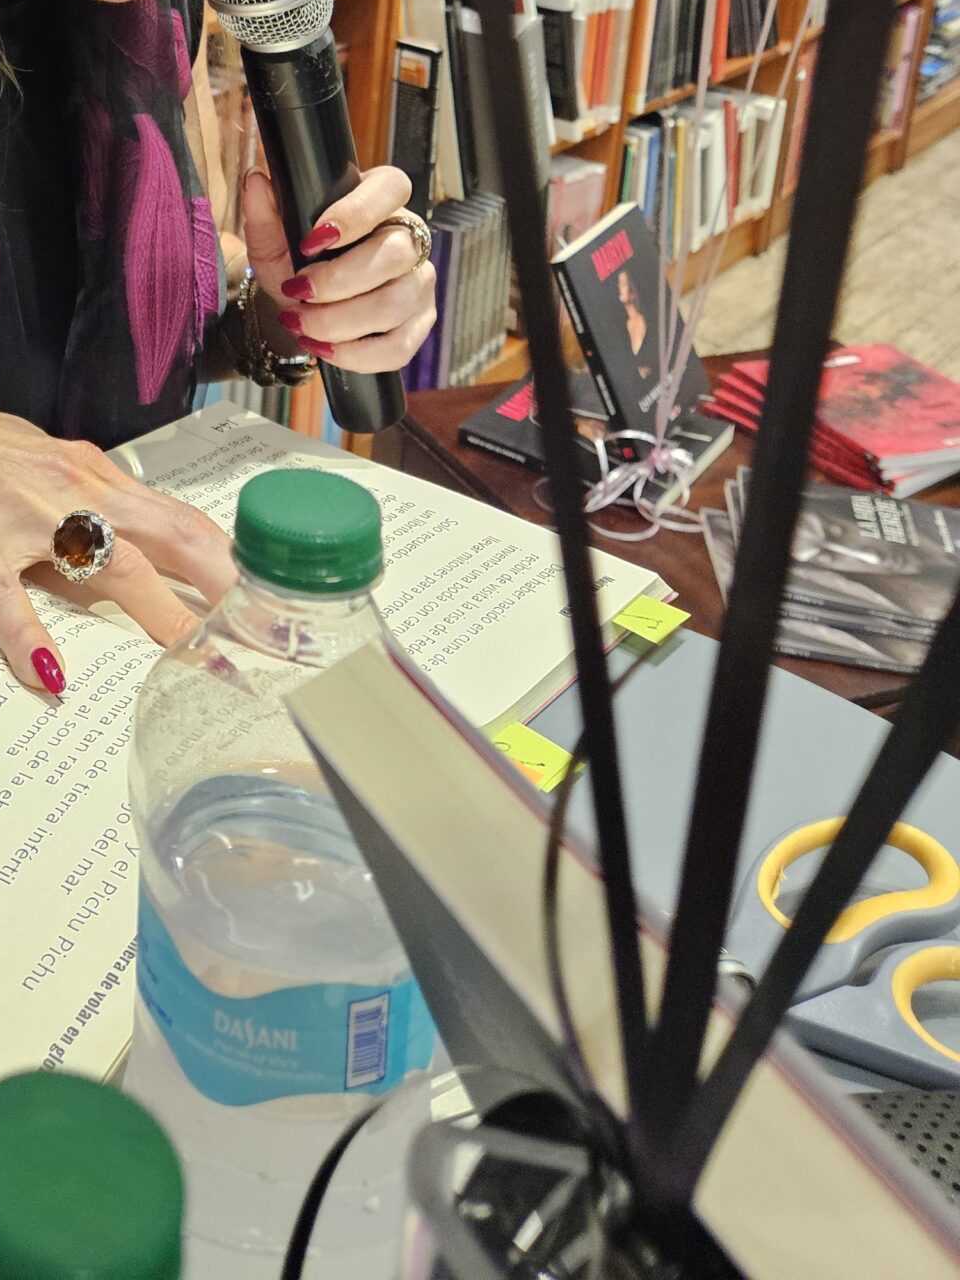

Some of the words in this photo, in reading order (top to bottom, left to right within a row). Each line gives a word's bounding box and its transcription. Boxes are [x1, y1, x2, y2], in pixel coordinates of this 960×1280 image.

[210, 419, 240, 433] 144
[394, 501, 417, 515] que
[418, 509, 437, 524] un
[392, 514, 428, 537] librito
[431, 517, 460, 533] Solo
[391, 530, 436, 560] recuerdo
[469, 535, 502, 555] llevar
[432, 551, 474, 579] mitones
[479, 544, 523, 572] inventar
[507, 553, 540, 581] recibir
[409, 574, 437, 595] para
[435, 577, 470, 602] boda
[457, 569, 485, 589] una
[495, 573, 515, 588] de
[511, 574, 546, 601] haber
[460, 600, 480, 611] la
[471, 583, 501, 609] visita
[415, 601, 440, 617] con
[442, 608, 467, 625] risa
[480, 597, 516, 625] nacido
[426, 623, 449, 643] de
[465, 622, 484, 636] en
[405, 634, 437, 655] Fede
[441, 634, 471, 655] cuna
[427, 649, 449, 666] de
[62, 651, 117, 693] dormía
[88, 658, 143, 703] cantaba
[4, 680, 21, 694] y
[73, 704, 91, 720] al
[98, 695, 134, 726] mira
[46, 719, 77, 747] son
[74, 729, 105, 752] tan
[26, 749, 50, 770] de
[84, 759, 108, 779] de
[10, 771, 35, 786] la
[44, 755, 78, 786] rara
[44, 782, 91, 824] tierra
[90, 828, 120, 858] del
[124, 841, 141, 858] y
[60, 857, 95, 896] mar
[109, 860, 129, 880] el
[66, 880, 119, 932] Pichu
[21, 935, 75, 991] Pichu
[99, 971, 121, 991] de
[74, 991, 107, 1028] volar
[59, 1025, 80, 1046] en
[214, 1008, 299, 1053] DASANI
[42, 1042, 66, 1070] glo
